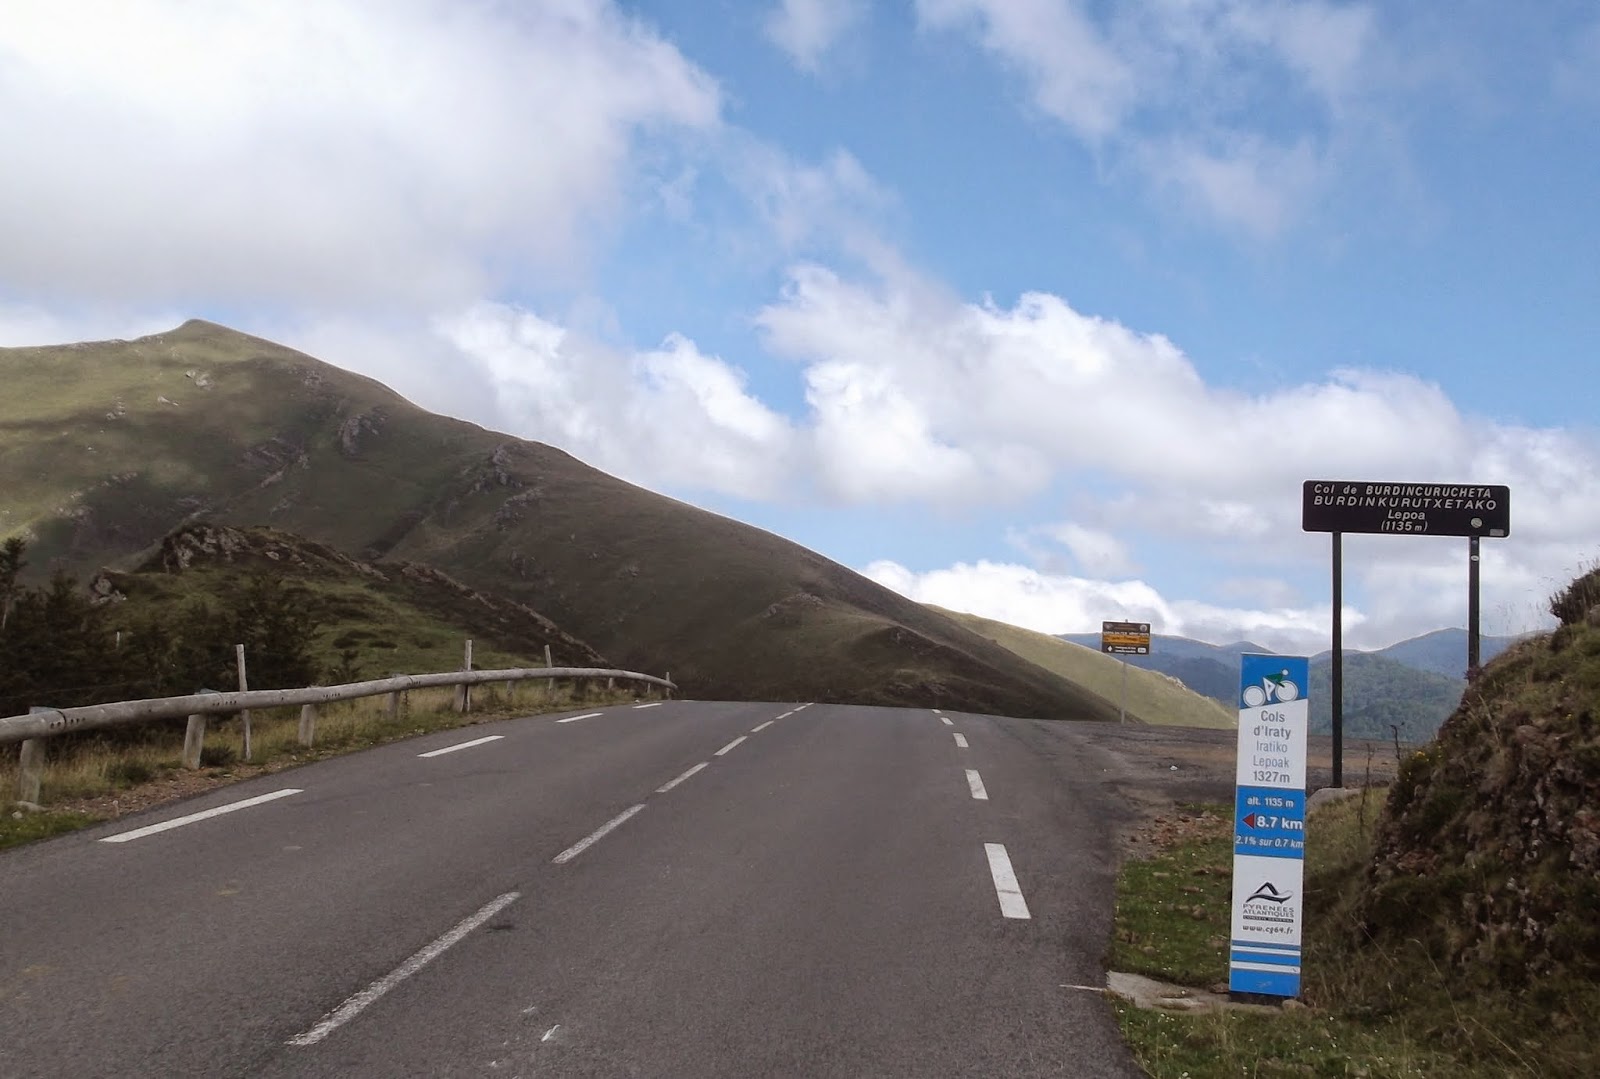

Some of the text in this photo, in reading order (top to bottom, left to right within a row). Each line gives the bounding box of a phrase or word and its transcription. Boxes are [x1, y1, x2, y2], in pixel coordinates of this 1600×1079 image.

[1314, 484, 1491, 498] Col de BURDINCURUCHETA
[1313, 495, 1497, 510] BURDINKURUTXETAKO
[1388, 510, 1426, 521] Lepoa
[1260, 710, 1285, 722] Cols
[1253, 725, 1291, 740] d'Iraty
[1256, 741, 1288, 753] Iratiko
[1253, 755, 1289, 768] Lepoak
[1253, 771, 1290, 783] 1327m
[1247, 797, 1294, 808] alt. 1135 m
[1256, 815, 1303, 830] 8.7 km
[1235, 835, 1304, 849] 2.1% sur 0.7 km
[1242, 909, 1294, 918] ATLANTIQUES
[1242, 925, 1293, 935] www.cg64.fr
